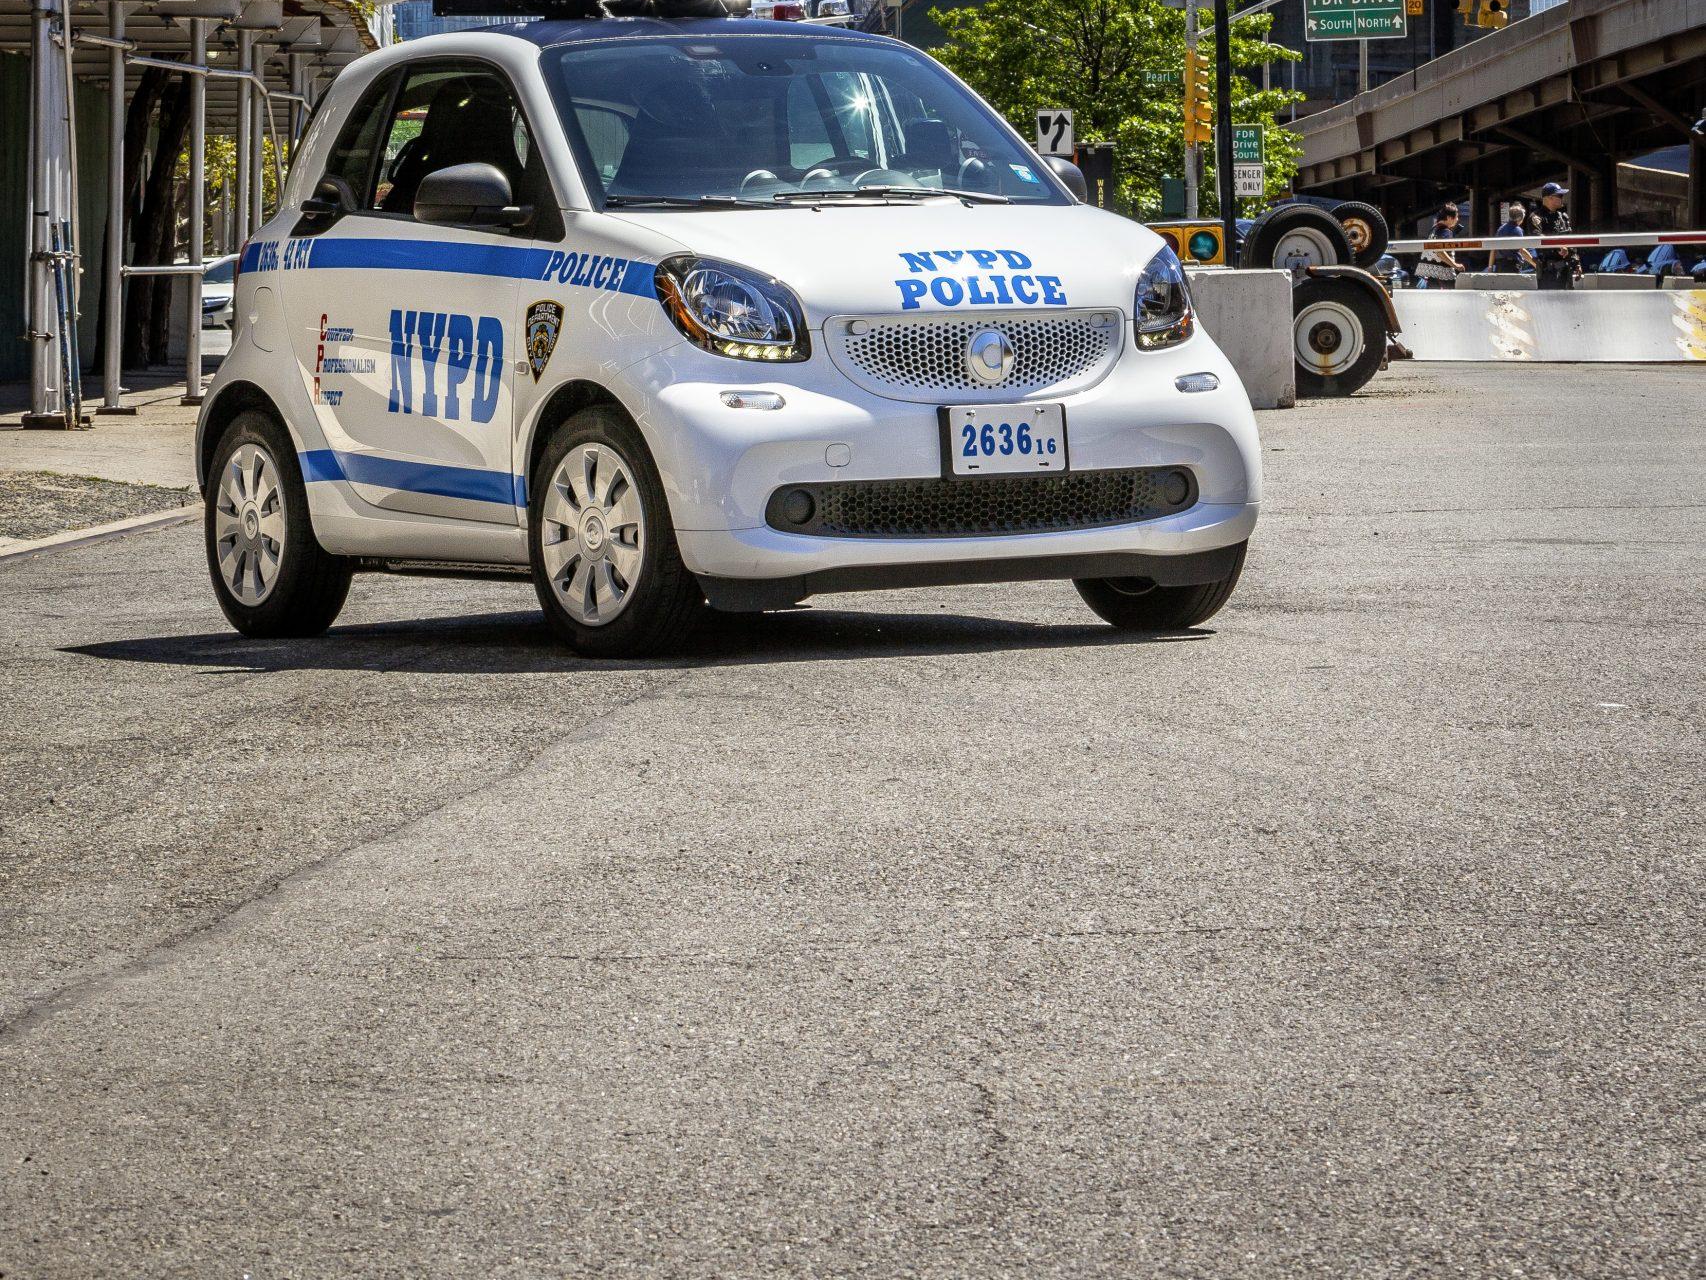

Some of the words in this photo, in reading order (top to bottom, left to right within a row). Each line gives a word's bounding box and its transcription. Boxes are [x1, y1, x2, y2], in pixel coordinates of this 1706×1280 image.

[1408, 0, 1421, 9] 20
[1320, 19, 1352, 30] SOUTH
[1357, 17, 1391, 29] NORTH
[1146, 71, 1171, 82] Pearl
[1236, 130, 1255, 138] FDR
[1232, 140, 1258, 149] Drive
[1232, 151, 1260, 159] SOUTH
[1233, 169, 1261, 179] SENGER
[1242, 181, 1261, 191] ONLY
[898, 249, 1032, 273] NYPD
[542, 250, 628, 291] POLICE
[895, 275, 1068, 310] POLICE
[535, 303, 557, 314] POLICE
[528, 312, 560, 326] DEPARTMENT
[315, 344, 376, 373] PROFESSIONALISM
[388, 309, 504, 423] NYPD
[962, 423, 1032, 457] 2636
[1036, 438, 1057, 455] 16
